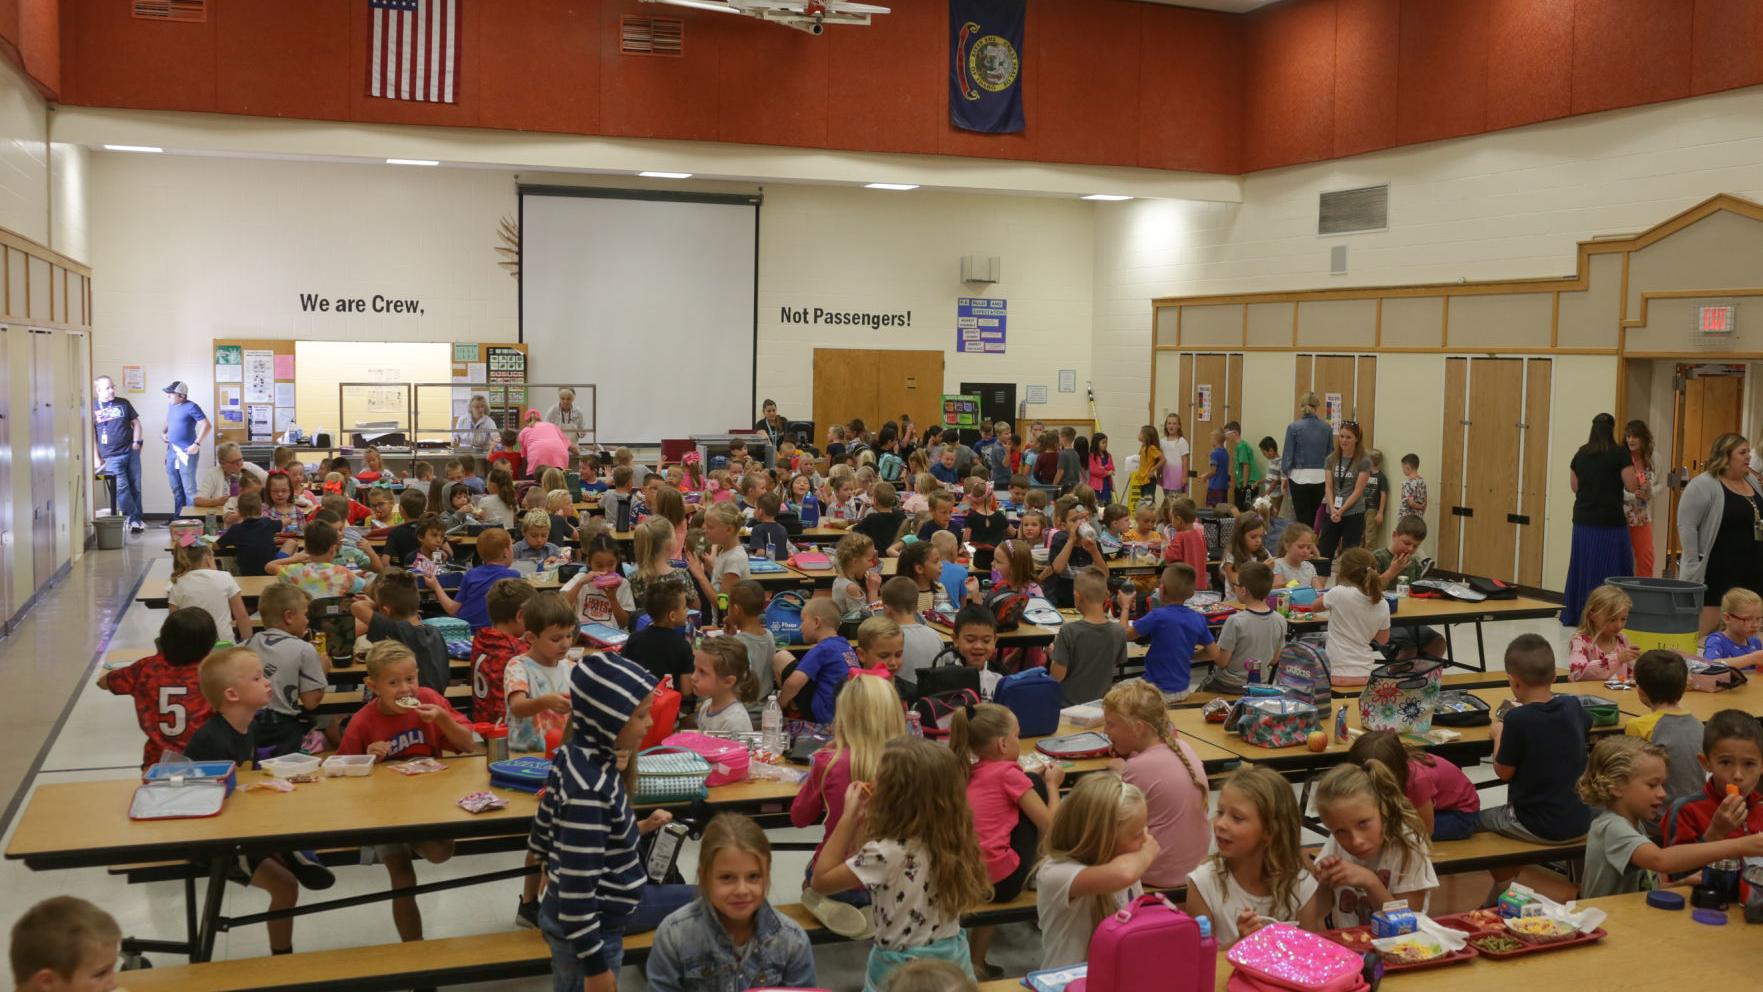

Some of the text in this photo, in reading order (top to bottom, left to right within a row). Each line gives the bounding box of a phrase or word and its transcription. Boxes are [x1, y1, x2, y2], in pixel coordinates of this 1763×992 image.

[299, 293, 425, 317] We are Crew,
[781, 306, 911, 330] Not Passengers!
[1703, 306, 1727, 330] EXIT
[473, 653, 489, 699] 6
[159, 686, 188, 737] 5
